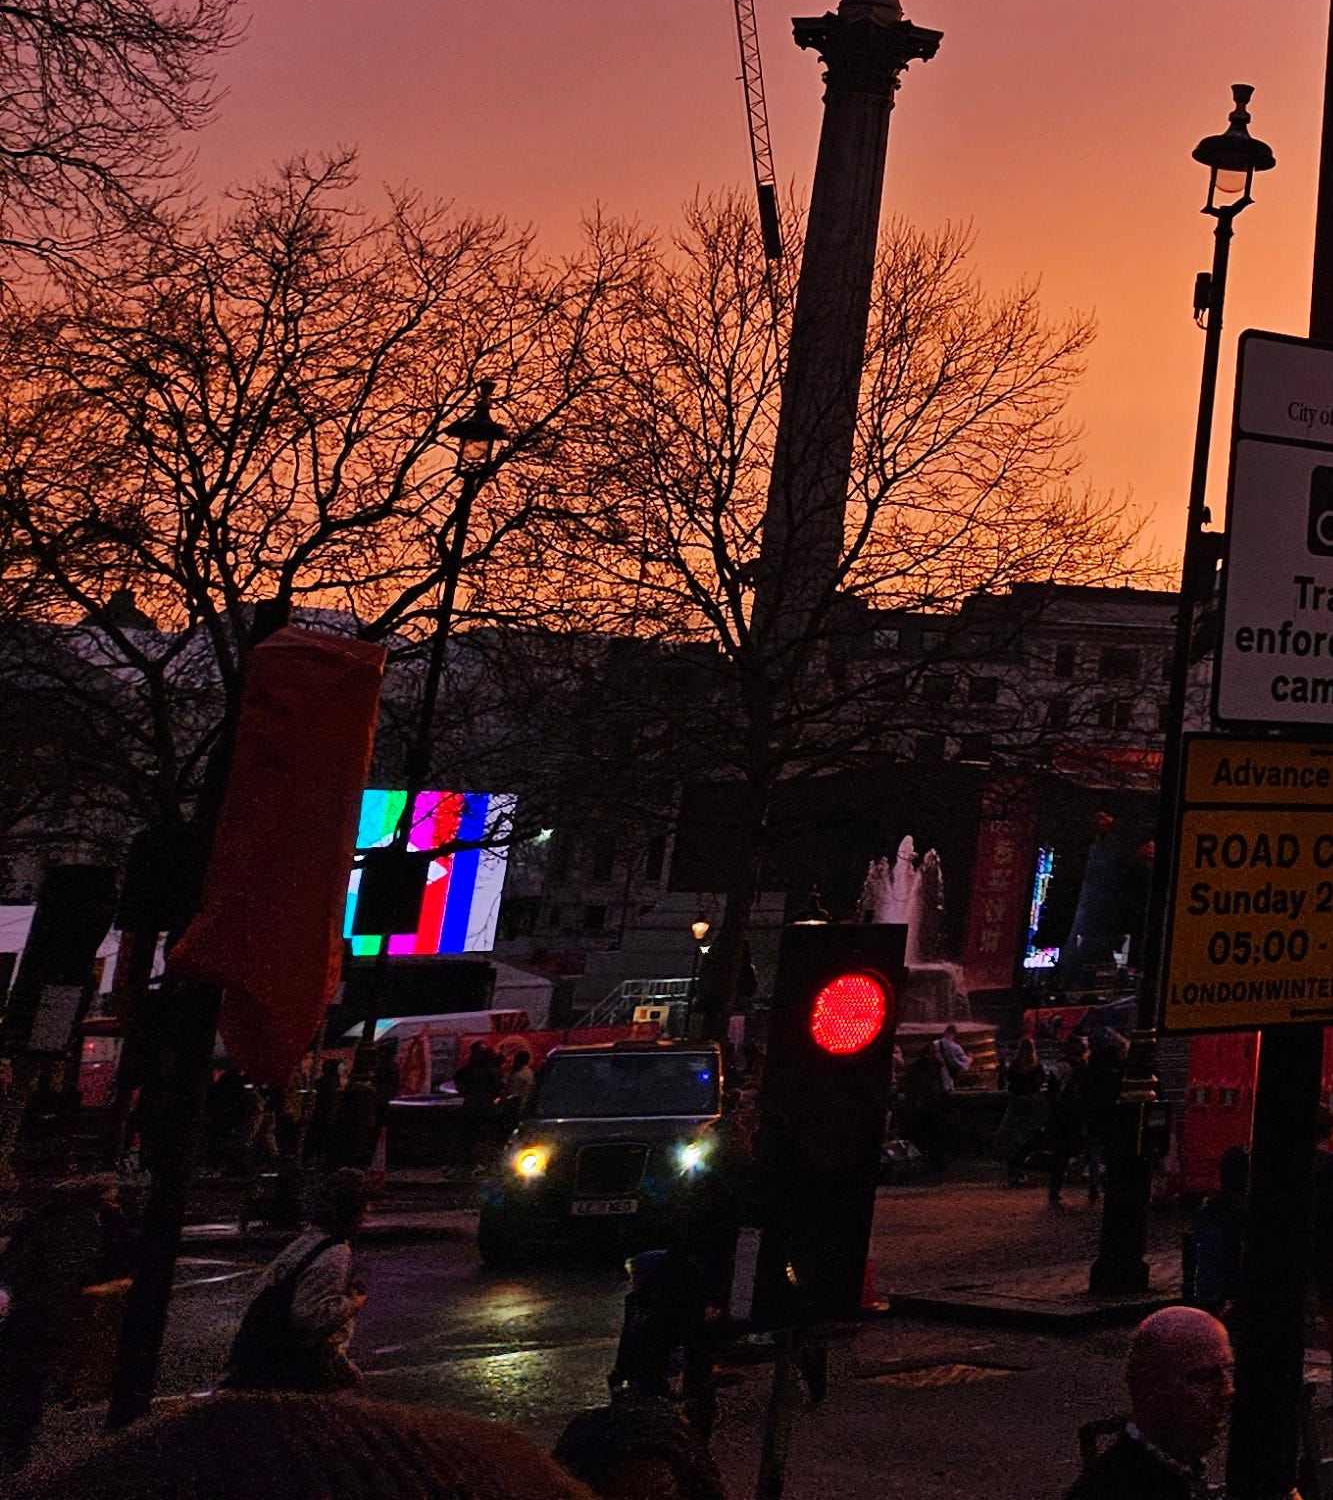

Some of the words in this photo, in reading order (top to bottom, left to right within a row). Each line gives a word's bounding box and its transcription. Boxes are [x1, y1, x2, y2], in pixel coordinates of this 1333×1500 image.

[1288, 401, 1316, 428] City
[1213, 758, 1330, 788] Advance
[1195, 833, 1300, 869] ROAD
[1187, 881, 1307, 920] Sunday
[1207, 929, 1308, 965] 05:00
